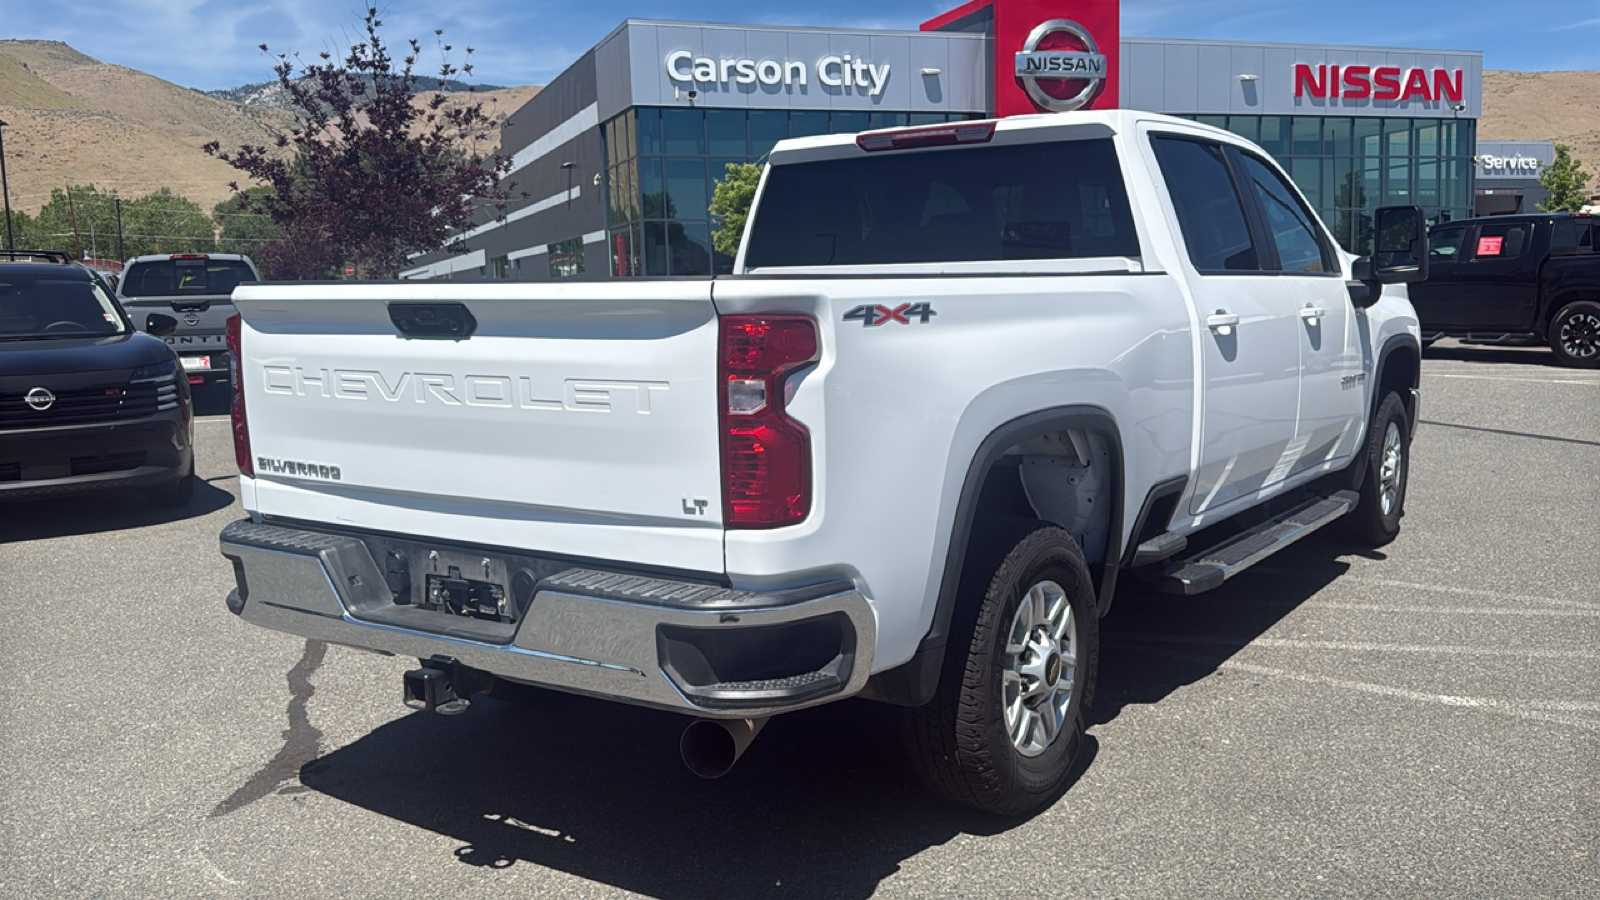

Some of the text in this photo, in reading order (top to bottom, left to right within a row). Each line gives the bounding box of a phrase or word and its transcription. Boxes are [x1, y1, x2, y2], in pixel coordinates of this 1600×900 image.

[666, 50, 891, 97] Carson City
[1026, 57, 1100, 72] NISSAN
[1294, 64, 1463, 102] NISSAN
[1482, 153, 1537, 170] Service
[263, 364, 671, 415] CHEVROLET
[257, 456, 342, 481] SILVERADO
[682, 498, 708, 516] LT
